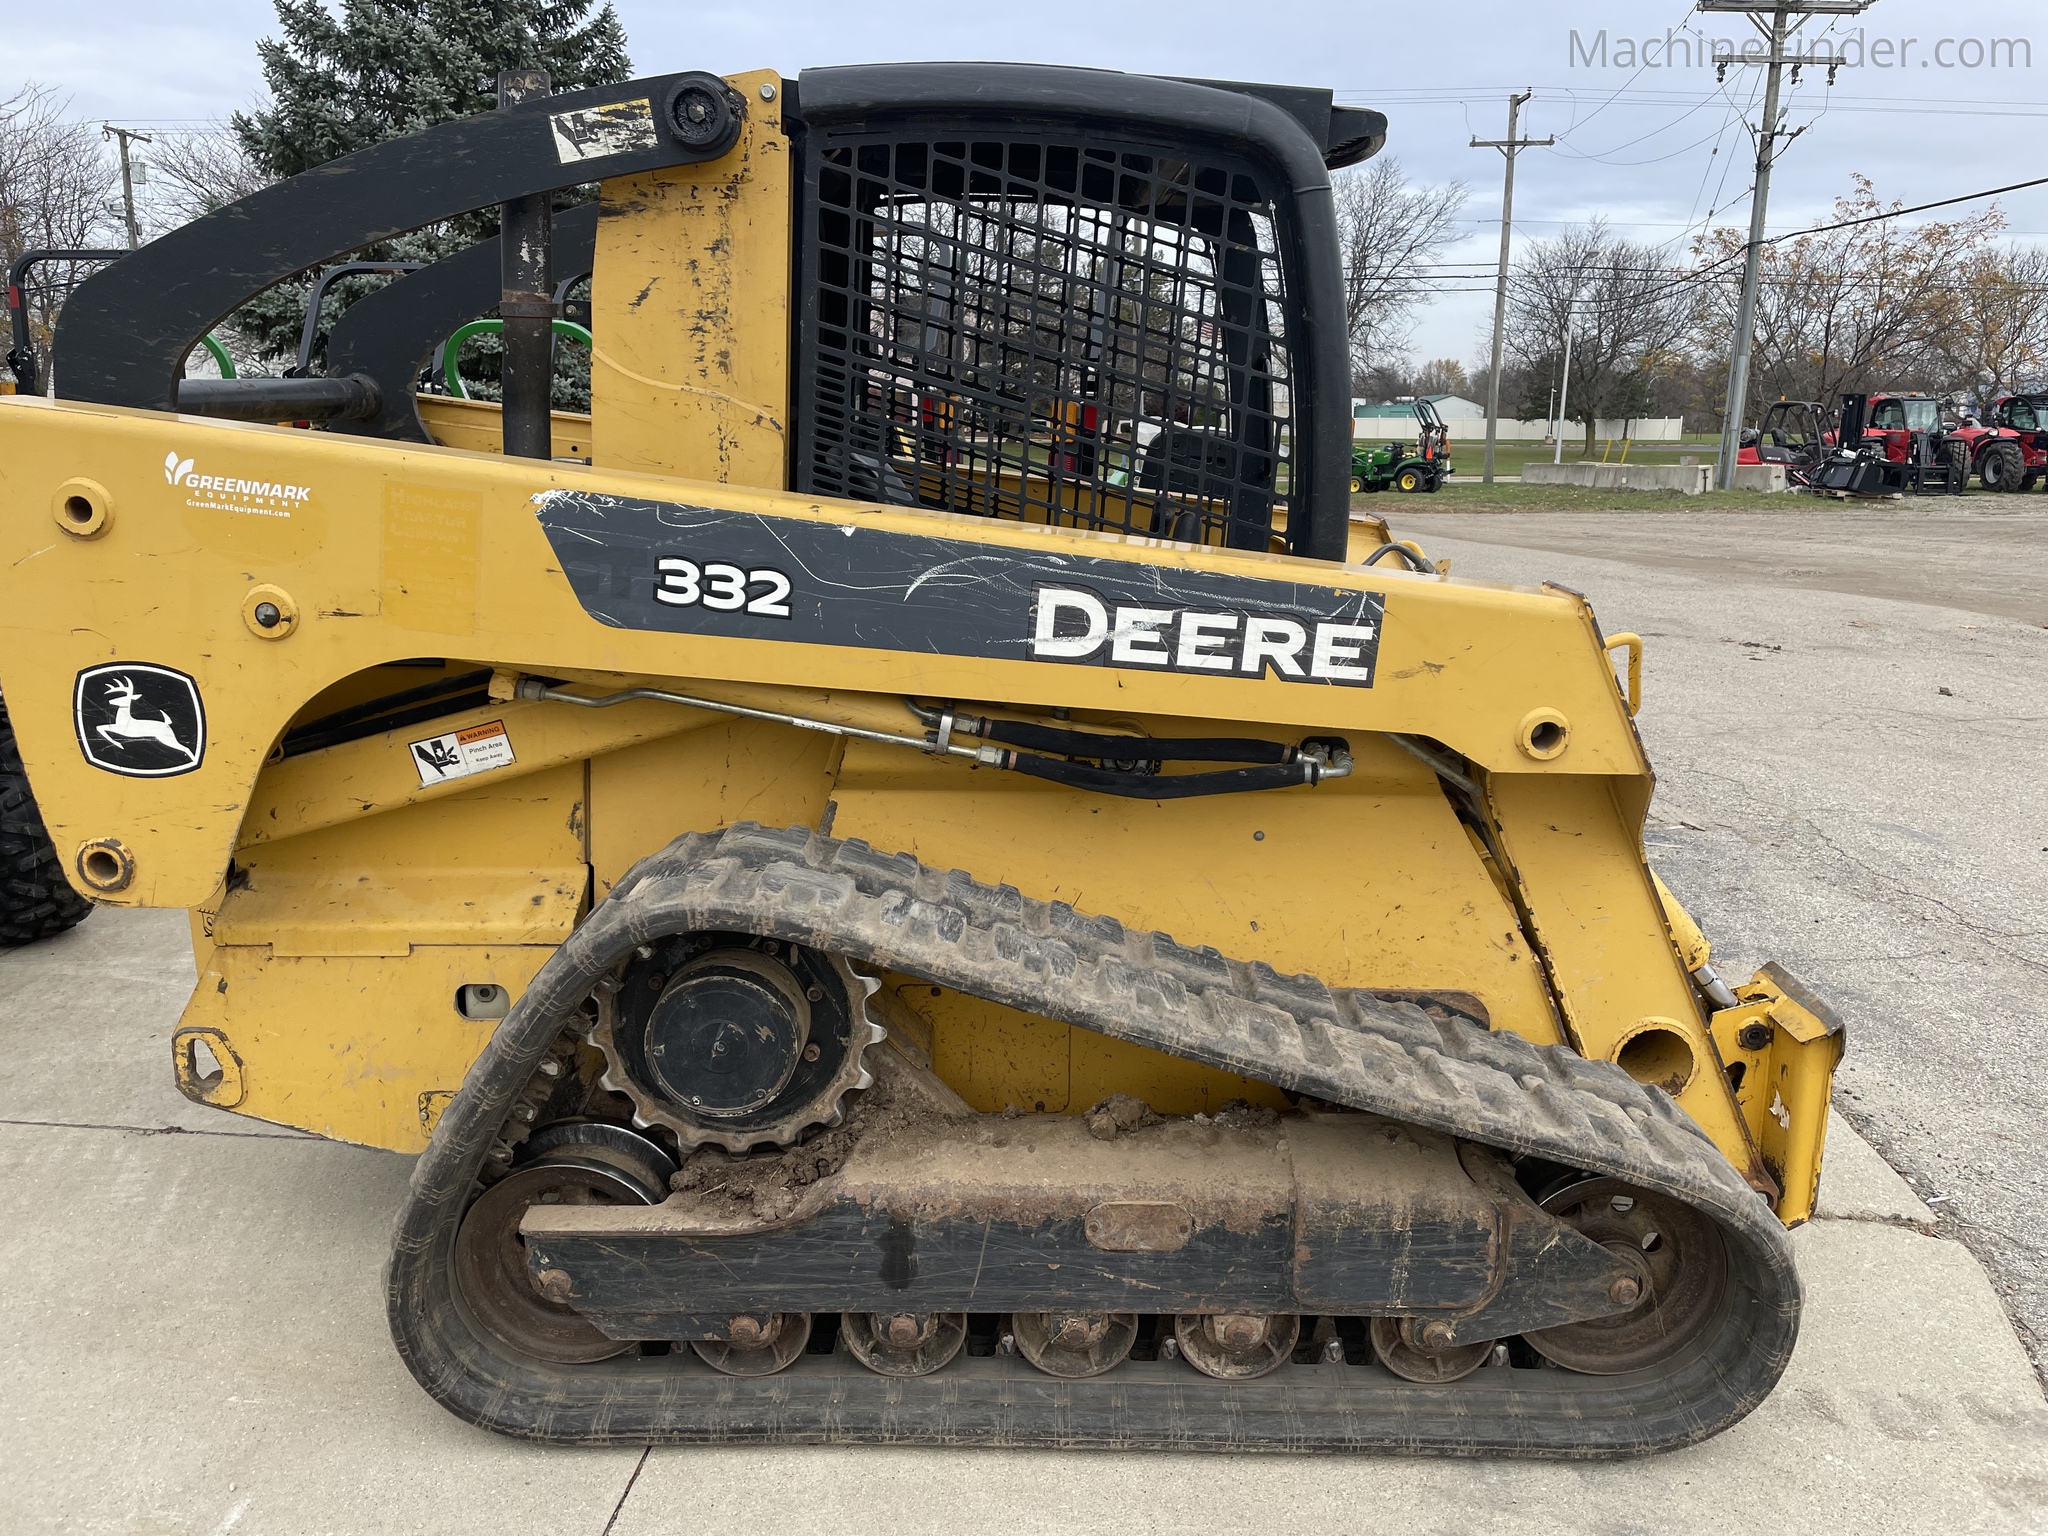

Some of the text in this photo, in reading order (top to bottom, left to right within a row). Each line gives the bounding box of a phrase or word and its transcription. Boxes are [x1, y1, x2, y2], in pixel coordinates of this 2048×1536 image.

[185, 473, 311, 502] GREENMARK
[186, 498, 291, 518] GreenMarkEquipment.com
[194, 489, 301, 508] EQUIPMENT
[655, 557, 791, 618] 332
[1032, 586, 1375, 682] DEERE
[466, 726, 500, 739] WARNING
[468, 741, 502, 755] Pinch Area
[475, 752, 503, 763] Keep Away
